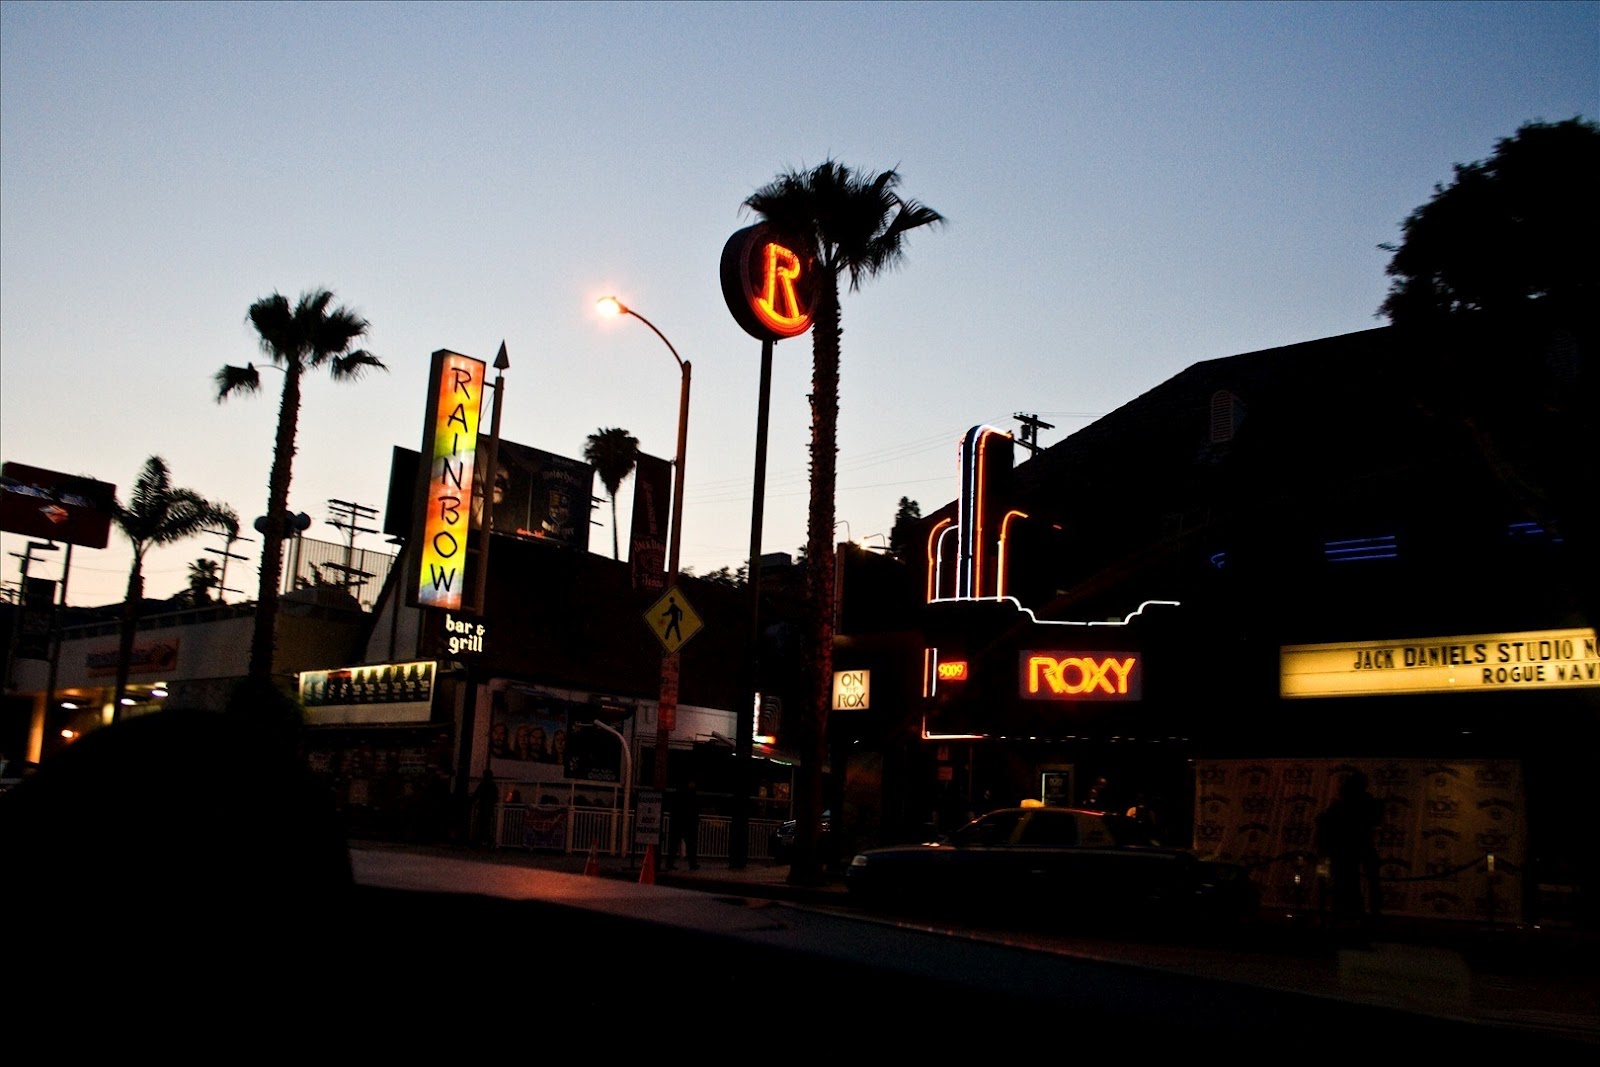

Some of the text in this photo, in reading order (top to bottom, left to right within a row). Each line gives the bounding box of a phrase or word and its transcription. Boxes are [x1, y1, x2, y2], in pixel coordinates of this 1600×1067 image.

[757, 242, 804, 321] R
[430, 367, 472, 593] RAINBOW
[445, 613, 486, 636] bar &
[447, 634, 483, 654] grill
[1354, 650, 1395, 669] JACK
[1403, 643, 1488, 667] DANIELS
[1497, 640, 1573, 663] STUDIO
[841, 672, 863, 687] ON
[938, 663, 964, 677] 9009
[1029, 657, 1136, 694] ROXY
[1482, 663, 1600, 684] ROGUE WAV
[838, 692, 865, 708] ROX
